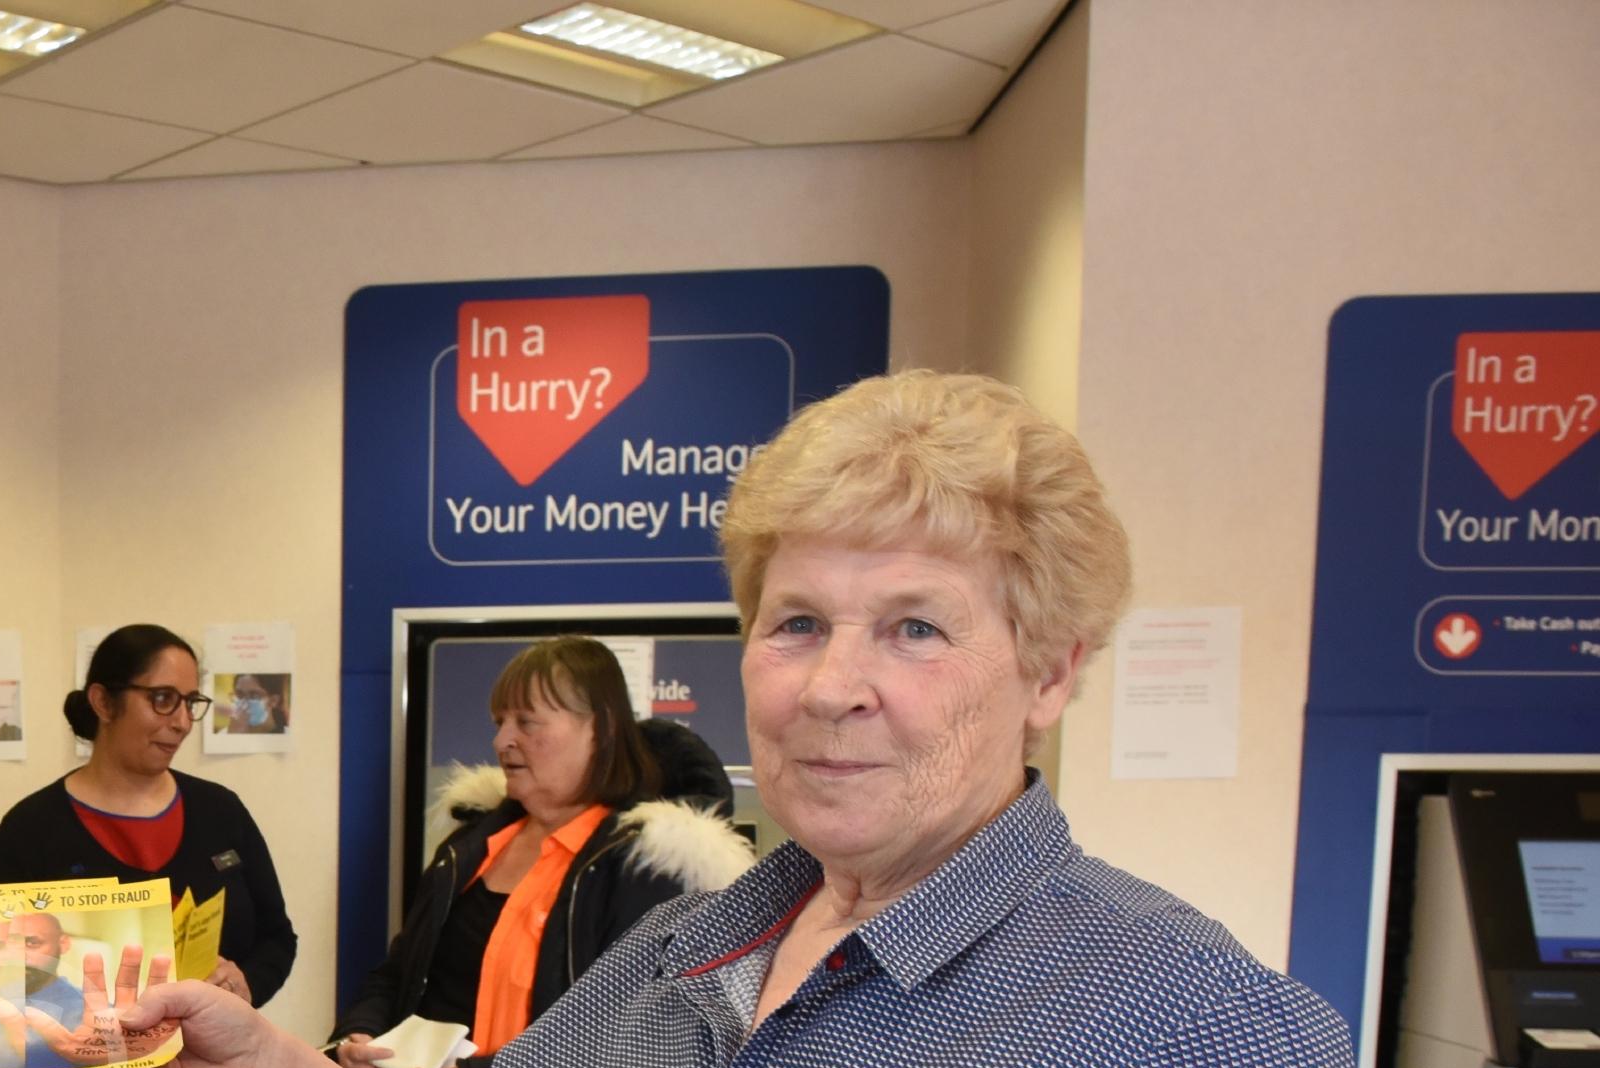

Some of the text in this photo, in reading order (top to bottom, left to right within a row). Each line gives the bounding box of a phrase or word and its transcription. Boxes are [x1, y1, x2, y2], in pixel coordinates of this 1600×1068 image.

[470, 317, 545, 359] In a
[1465, 347, 1536, 384] In a
[469, 367, 612, 420] Hurry?
[1462, 395, 1598, 442] Hurry?
[447, 496, 533, 535] Your
[545, 494, 669, 538] Money
[1437, 508, 1600, 543] Your Mon
[1504, 616, 1537, 631] Take
[60, 889, 151, 908] TO STOP FRAUD
